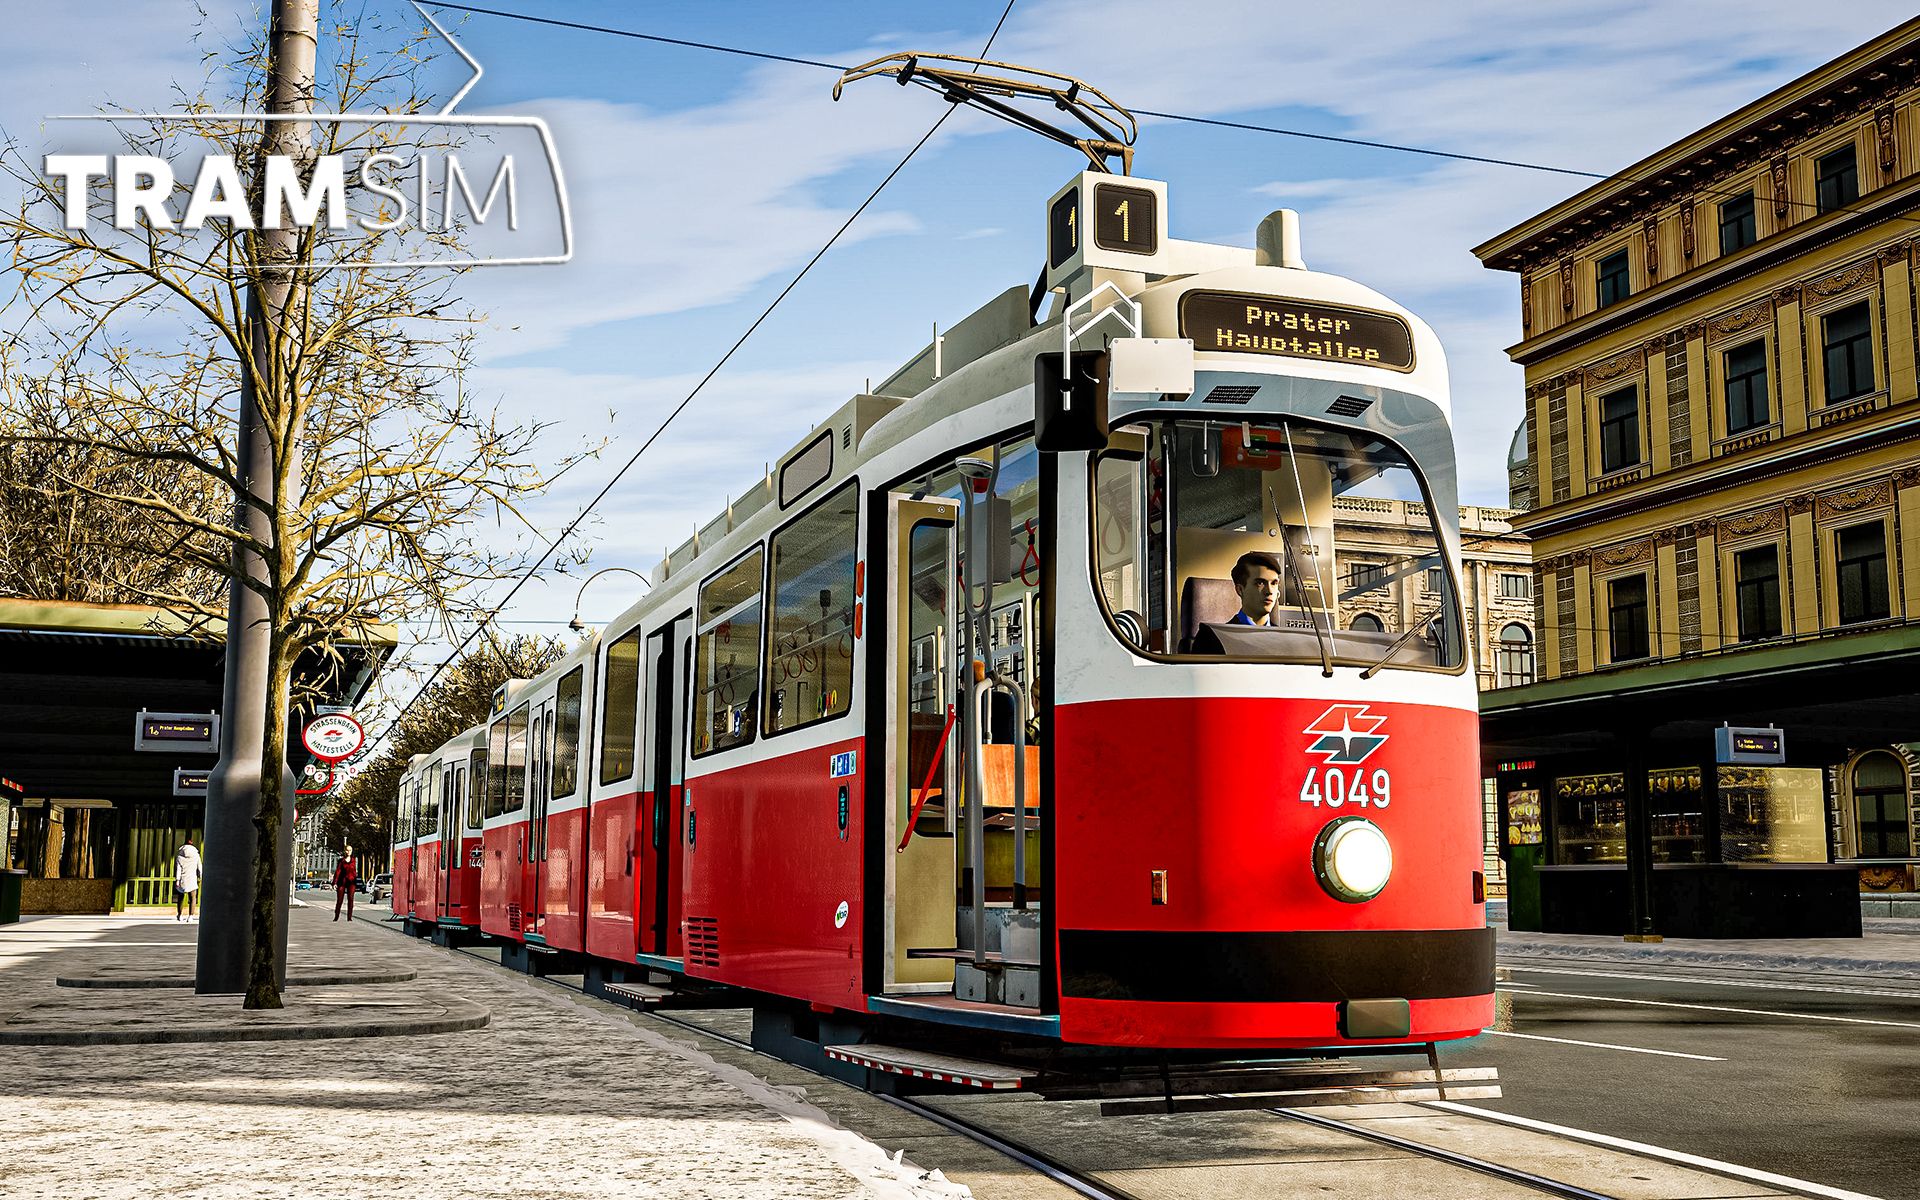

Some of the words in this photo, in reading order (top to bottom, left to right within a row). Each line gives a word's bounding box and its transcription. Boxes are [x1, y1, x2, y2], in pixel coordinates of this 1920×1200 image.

[1068, 206, 1076, 248] 1
[1115, 200, 1129, 241] 1
[1246, 305, 1351, 335] Prater
[310, 718, 357, 735] STRASSENBAHN
[311, 740, 355, 754] HALTESTELLE
[306, 766, 315, 775] 71
[349, 767, 356, 775] D
[1299, 766, 1391, 809] 4049
